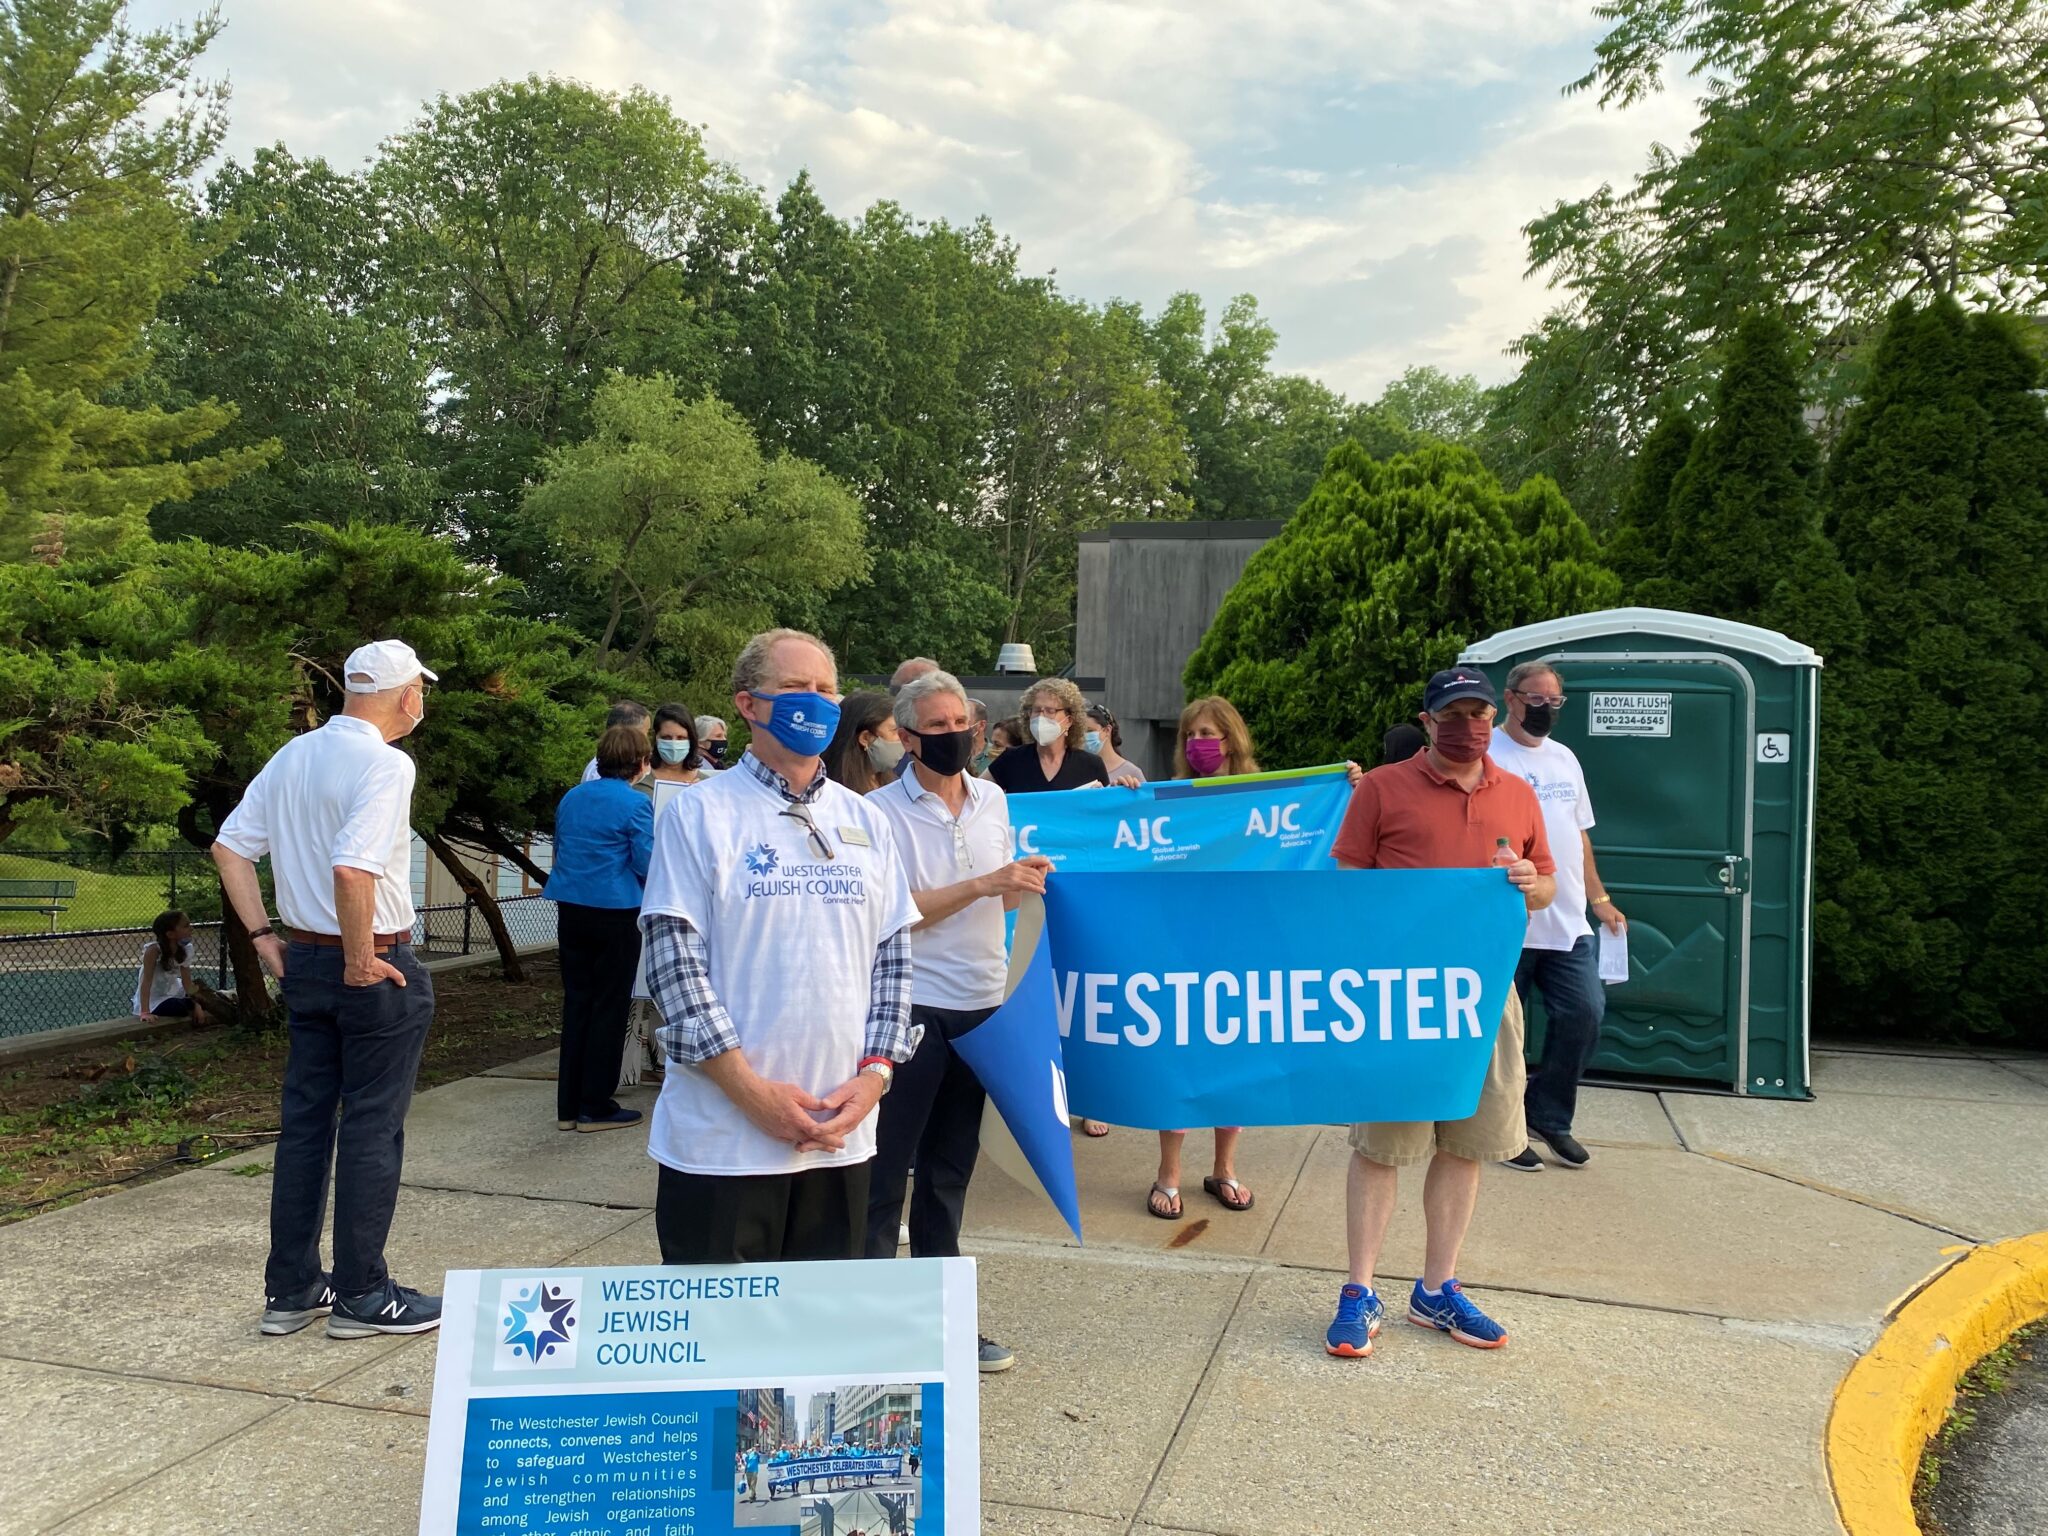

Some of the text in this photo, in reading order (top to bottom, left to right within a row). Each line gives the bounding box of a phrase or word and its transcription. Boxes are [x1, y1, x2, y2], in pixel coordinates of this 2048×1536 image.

[1594, 697, 1667, 708] A ROYAL FLUSH
[1596, 715, 1665, 725] 800-234-6545
[1245, 803, 1300, 838] AJC
[1113, 816, 1173, 851] AJC
[1279, 829, 1325, 841] Global Jewish
[1152, 843, 1201, 854] Global Jewish
[1280, 840, 1312, 849] Advocacy
[1153, 853, 1188, 862] Advocacy
[782, 865, 863, 877] WESTCHESTER
[745, 880, 865, 899] JEWISH COUNCIL
[602, 1276, 780, 1301] WESTCHESTER
[598, 1310, 689, 1333] JEWISH
[597, 1342, 706, 1365] COUNCIL
[490, 1411, 698, 1430] The Westchester Jewish Council
[488, 1430, 698, 1450] connects, convenes and helps
[486, 1449, 698, 1469] to safeguard Westchester's
[786, 1459, 883, 1477] WESTCHESTER CELEBRATES ISRAEL
[484, 1468, 697, 1488] Jewish communities
[483, 1486, 696, 1507] and strengthen relationships
[481, 1505, 695, 1527] among Jewish organizations
[625, 1526, 650, 1536] and
[665, 1524, 694, 1536] faith
